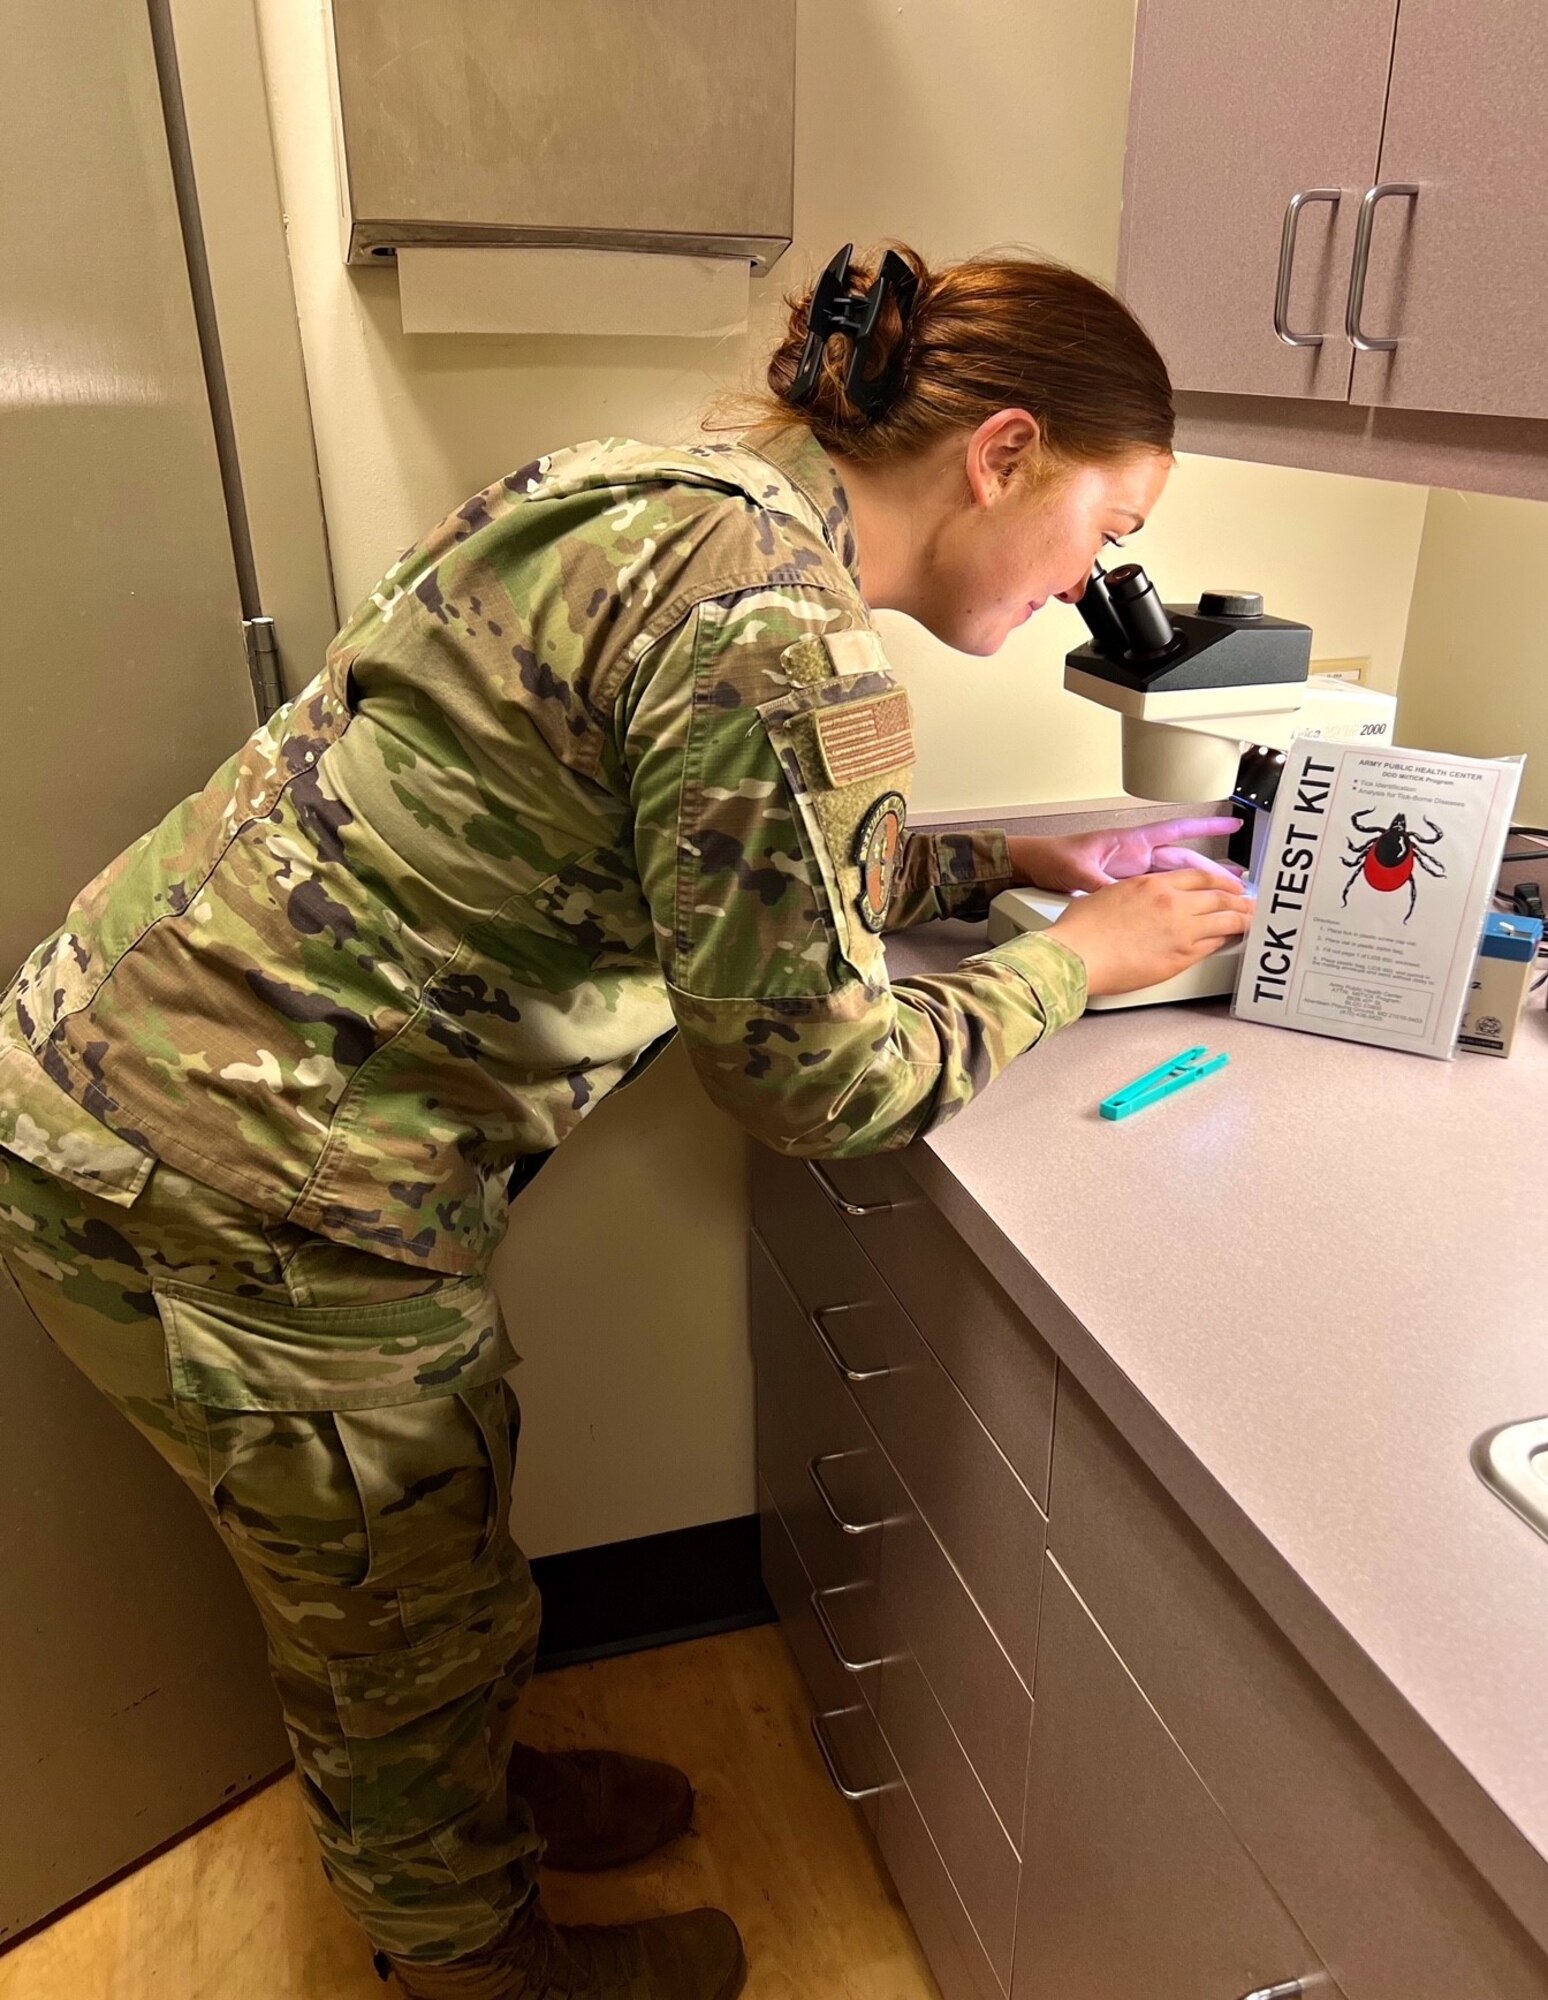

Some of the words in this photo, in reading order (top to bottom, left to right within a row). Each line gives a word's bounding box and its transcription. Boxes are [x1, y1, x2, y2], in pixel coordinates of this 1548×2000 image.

[1359, 723, 1387, 736] 2000
[1359, 759, 1382, 767] ARMY
[1384, 762, 1413, 771] PUBLIC
[1415, 767, 1447, 775] HEALTH
[1449, 771, 1483, 780] CENTER
[1293, 756, 1335, 816] KIT
[1375, 782, 1417, 791] Identification
[1425, 777, 1454, 785] Program
[1270, 824, 1318, 913] TEST
[1253, 923, 1298, 1003] TICK
